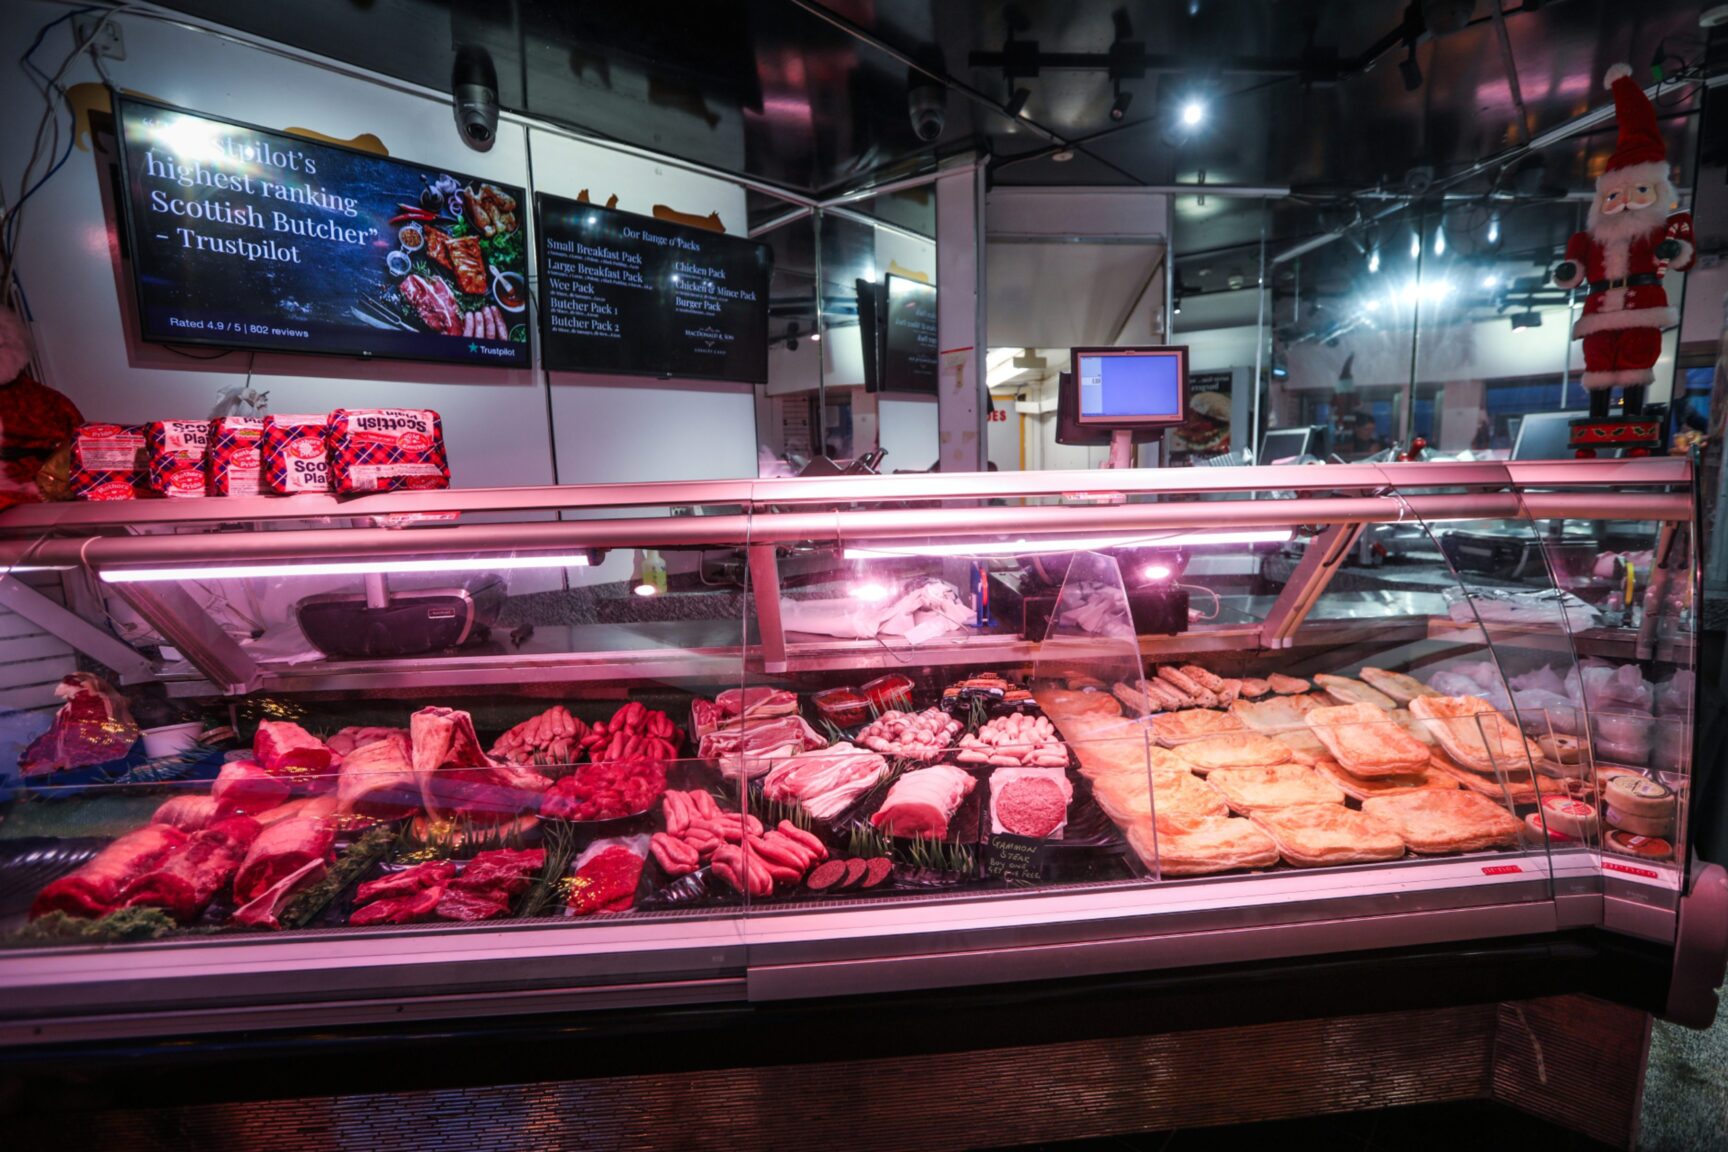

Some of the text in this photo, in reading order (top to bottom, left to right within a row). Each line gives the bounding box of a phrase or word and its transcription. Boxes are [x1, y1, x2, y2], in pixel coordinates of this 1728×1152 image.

[146, 152, 358, 217] highest ranking
[151, 191, 264, 229] Scottish
[176, 228, 301, 263] Trustpilot
[642, 230, 668, 246] Range
[547, 238, 574, 252] Small
[577, 243, 619, 260] Breakfast
[622, 251, 642, 264] Pack
[548, 258, 576, 272] Large
[578, 263, 621, 280] Breakfast
[623, 271, 643, 283] Pack
[675, 262, 707, 276] Chicken
[708, 267, 726, 279] Pack
[549, 278, 570, 290] Wee
[572, 281, 595, 294] Pack
[675, 280, 707, 293] Chicken
[717, 286, 739, 298] Mince
[740, 290, 757, 301] Pack
[550, 297, 589, 312] Butcher
[591, 302, 613, 315] Pack
[675, 296, 703, 309] Burger
[704, 301, 722, 311] Pack
[170, 317, 204, 329] Rated
[207, 321, 224, 330] 4.9
[234, 323, 241, 332] 5
[250, 324, 269, 335] 802
[271, 328, 309, 338] reviews
[551, 315, 620, 332] Butcher Pack 2
[480, 345, 515, 357] Trustpilot
[173, 422, 209, 433] Sco
[358, 417, 426, 433] Scottish
[295, 461, 328, 473] Sco
